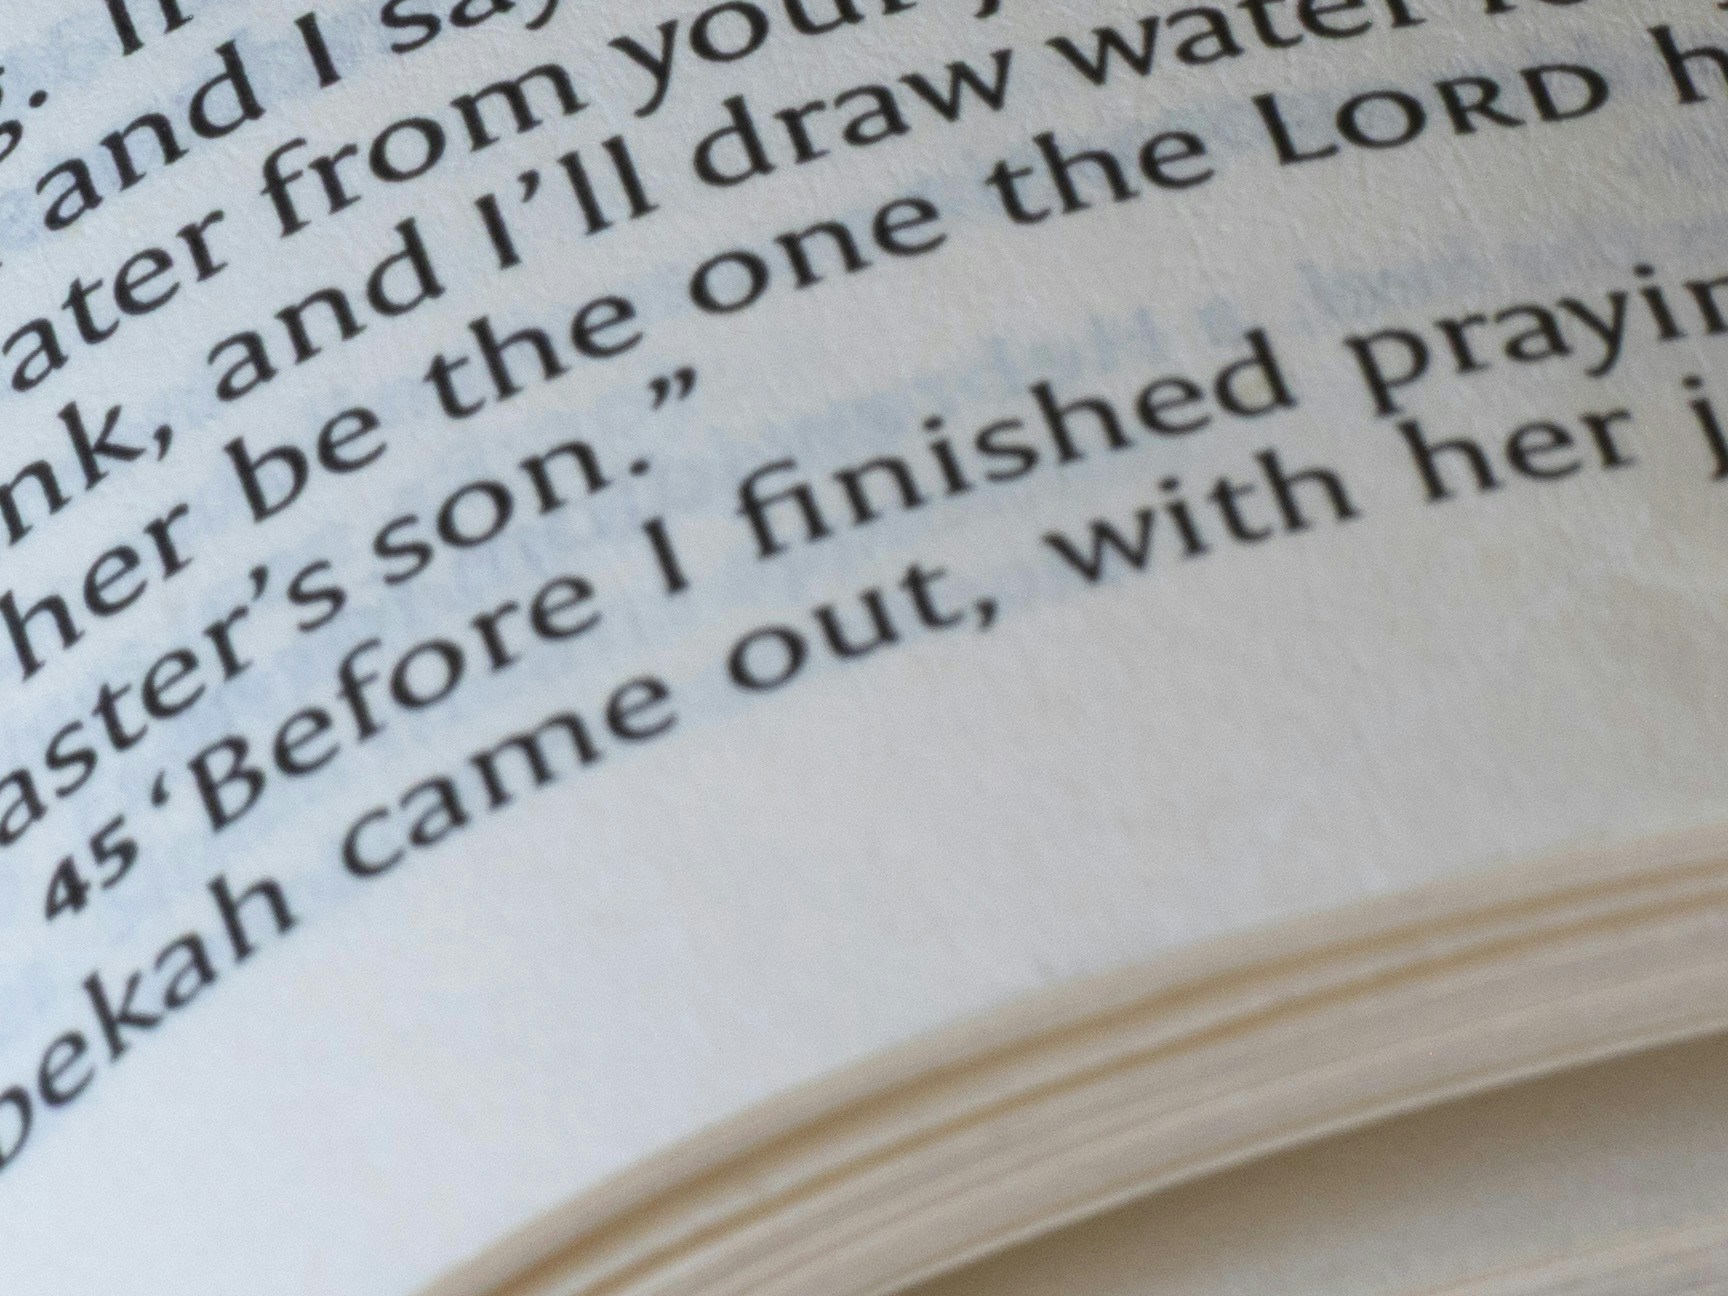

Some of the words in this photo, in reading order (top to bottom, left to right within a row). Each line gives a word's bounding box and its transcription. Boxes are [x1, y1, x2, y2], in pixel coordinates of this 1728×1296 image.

[33, 37, 268, 234] and
[292, 9, 344, 91] I
[205, 215, 448, 405] and
[472, 133, 660, 272] I’ll
[690, 46, 1015, 190] draw
[221, 405, 388, 525] be
[421, 293, 644, 422] the
[686, 194, 949, 317] one
[982, 128, 1217, 227] the
[639, 515, 691, 597] I
[735, 325, 1299, 561] finished
[339, 675, 677, 881] came
[724, 563, 1000, 694] out,
[1041, 447, 1360, 586] with
[1394, 407, 1633, 505] her
